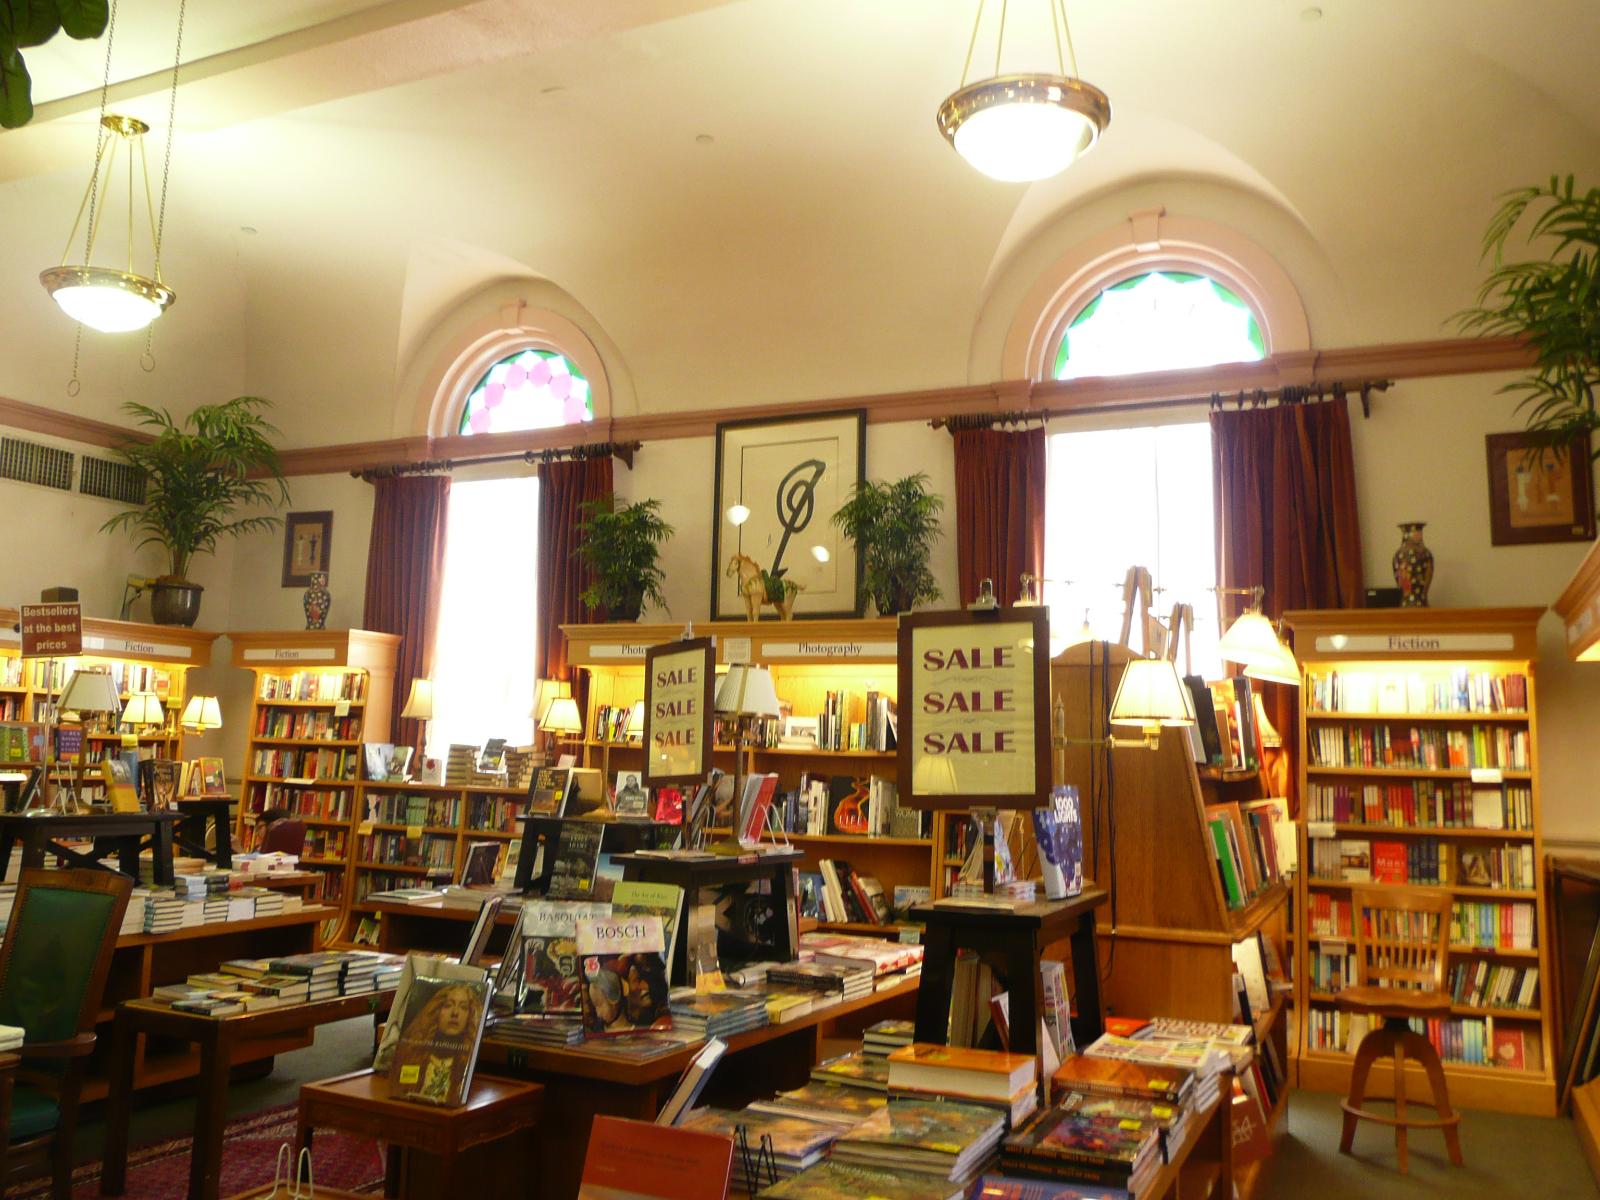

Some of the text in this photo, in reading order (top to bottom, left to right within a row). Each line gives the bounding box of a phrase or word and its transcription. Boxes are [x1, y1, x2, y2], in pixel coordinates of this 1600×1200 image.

[23, 605, 79, 617] Bestsellers
[23, 622, 77, 634] at the best
[36, 640, 67, 652] prices
[125, 641, 154, 653] Fiction
[799, 641, 863, 657] Photography
[1388, 636, 1440, 650] Fiction
[275, 648, 299, 659] Fiction
[923, 646, 1015, 671] SALE
[656, 667, 697, 688] SALE
[655, 699, 696, 719] SALE
[923, 689, 1016, 714] SALE
[655, 728, 696, 748] SALE
[924, 730, 1016, 755] SALE
[596, 925, 646, 939] BOSCH
